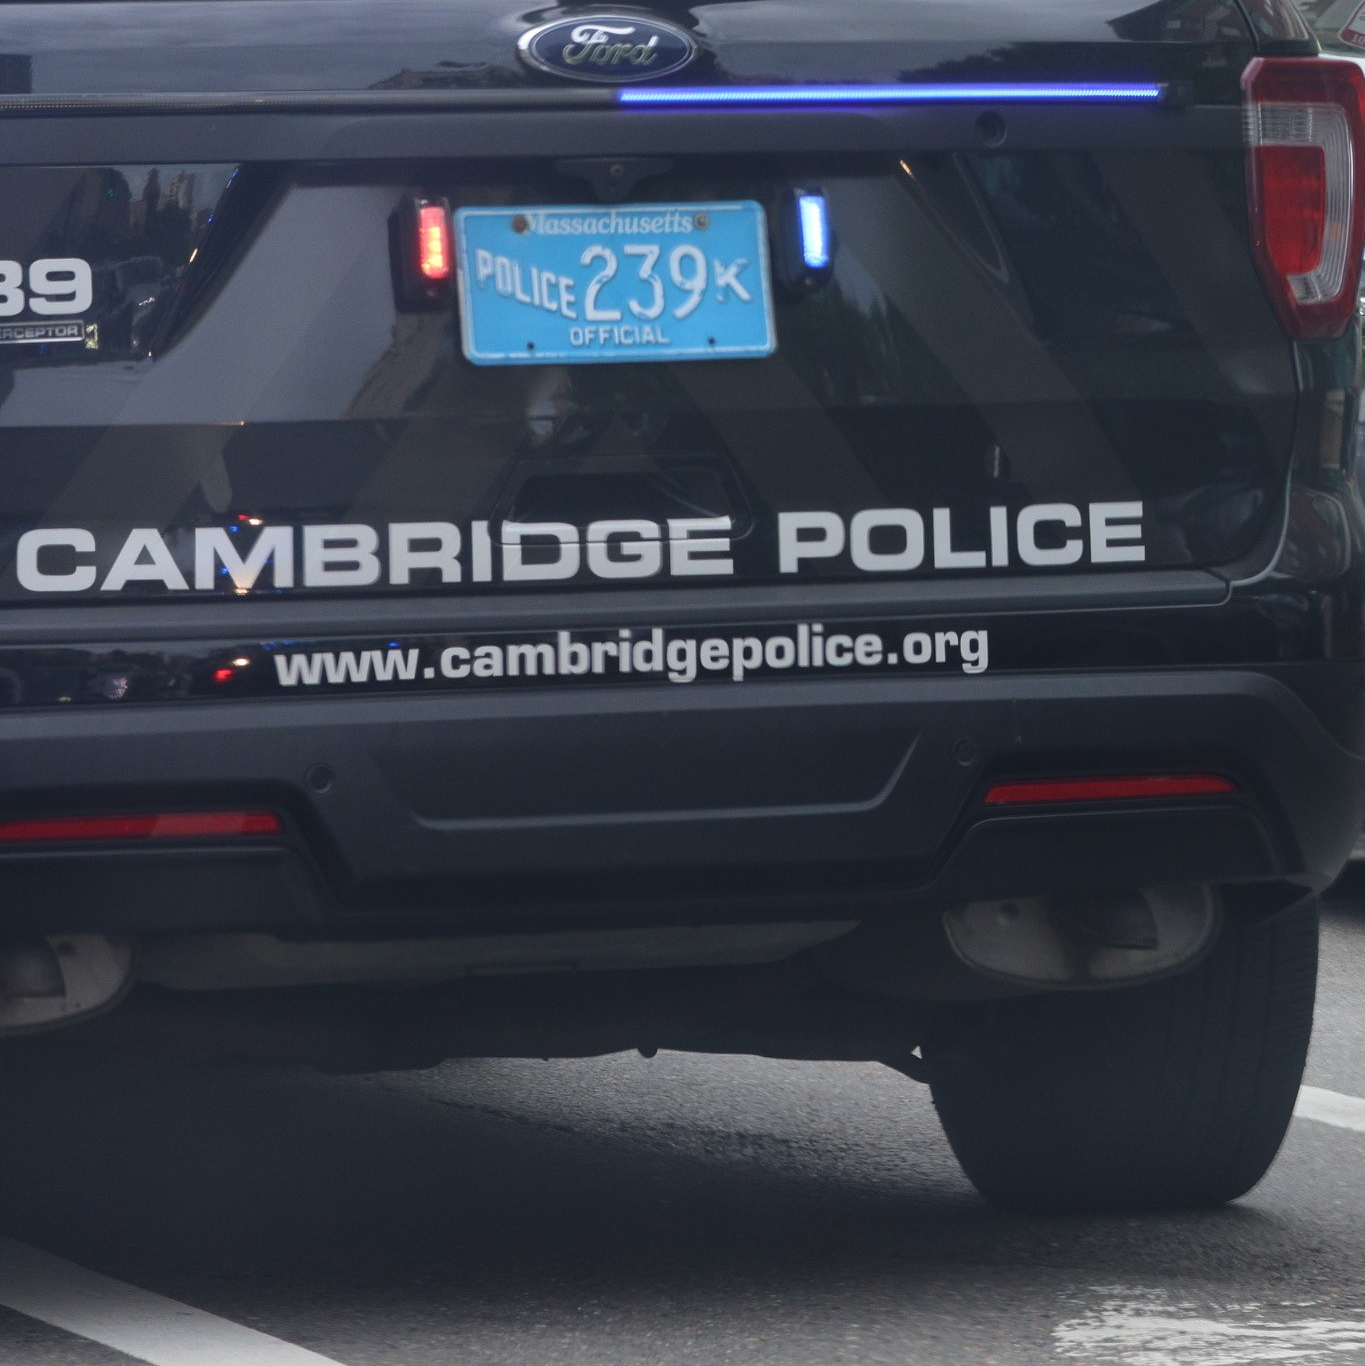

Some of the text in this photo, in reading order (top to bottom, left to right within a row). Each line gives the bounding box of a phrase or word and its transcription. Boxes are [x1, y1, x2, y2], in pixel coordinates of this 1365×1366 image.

[562, 24, 661, 66] Ford
[524, 211, 694, 235] Massachusetts
[475, 243, 753, 323] POLICE 239 K
[0, 325, 79, 339] RCEPTOR
[570, 325, 672, 347] OFFICIAL
[15, 501, 1147, 592] CAMBRIDGE POLICE
[275, 622, 991, 688] www.cambridgepolice.org
